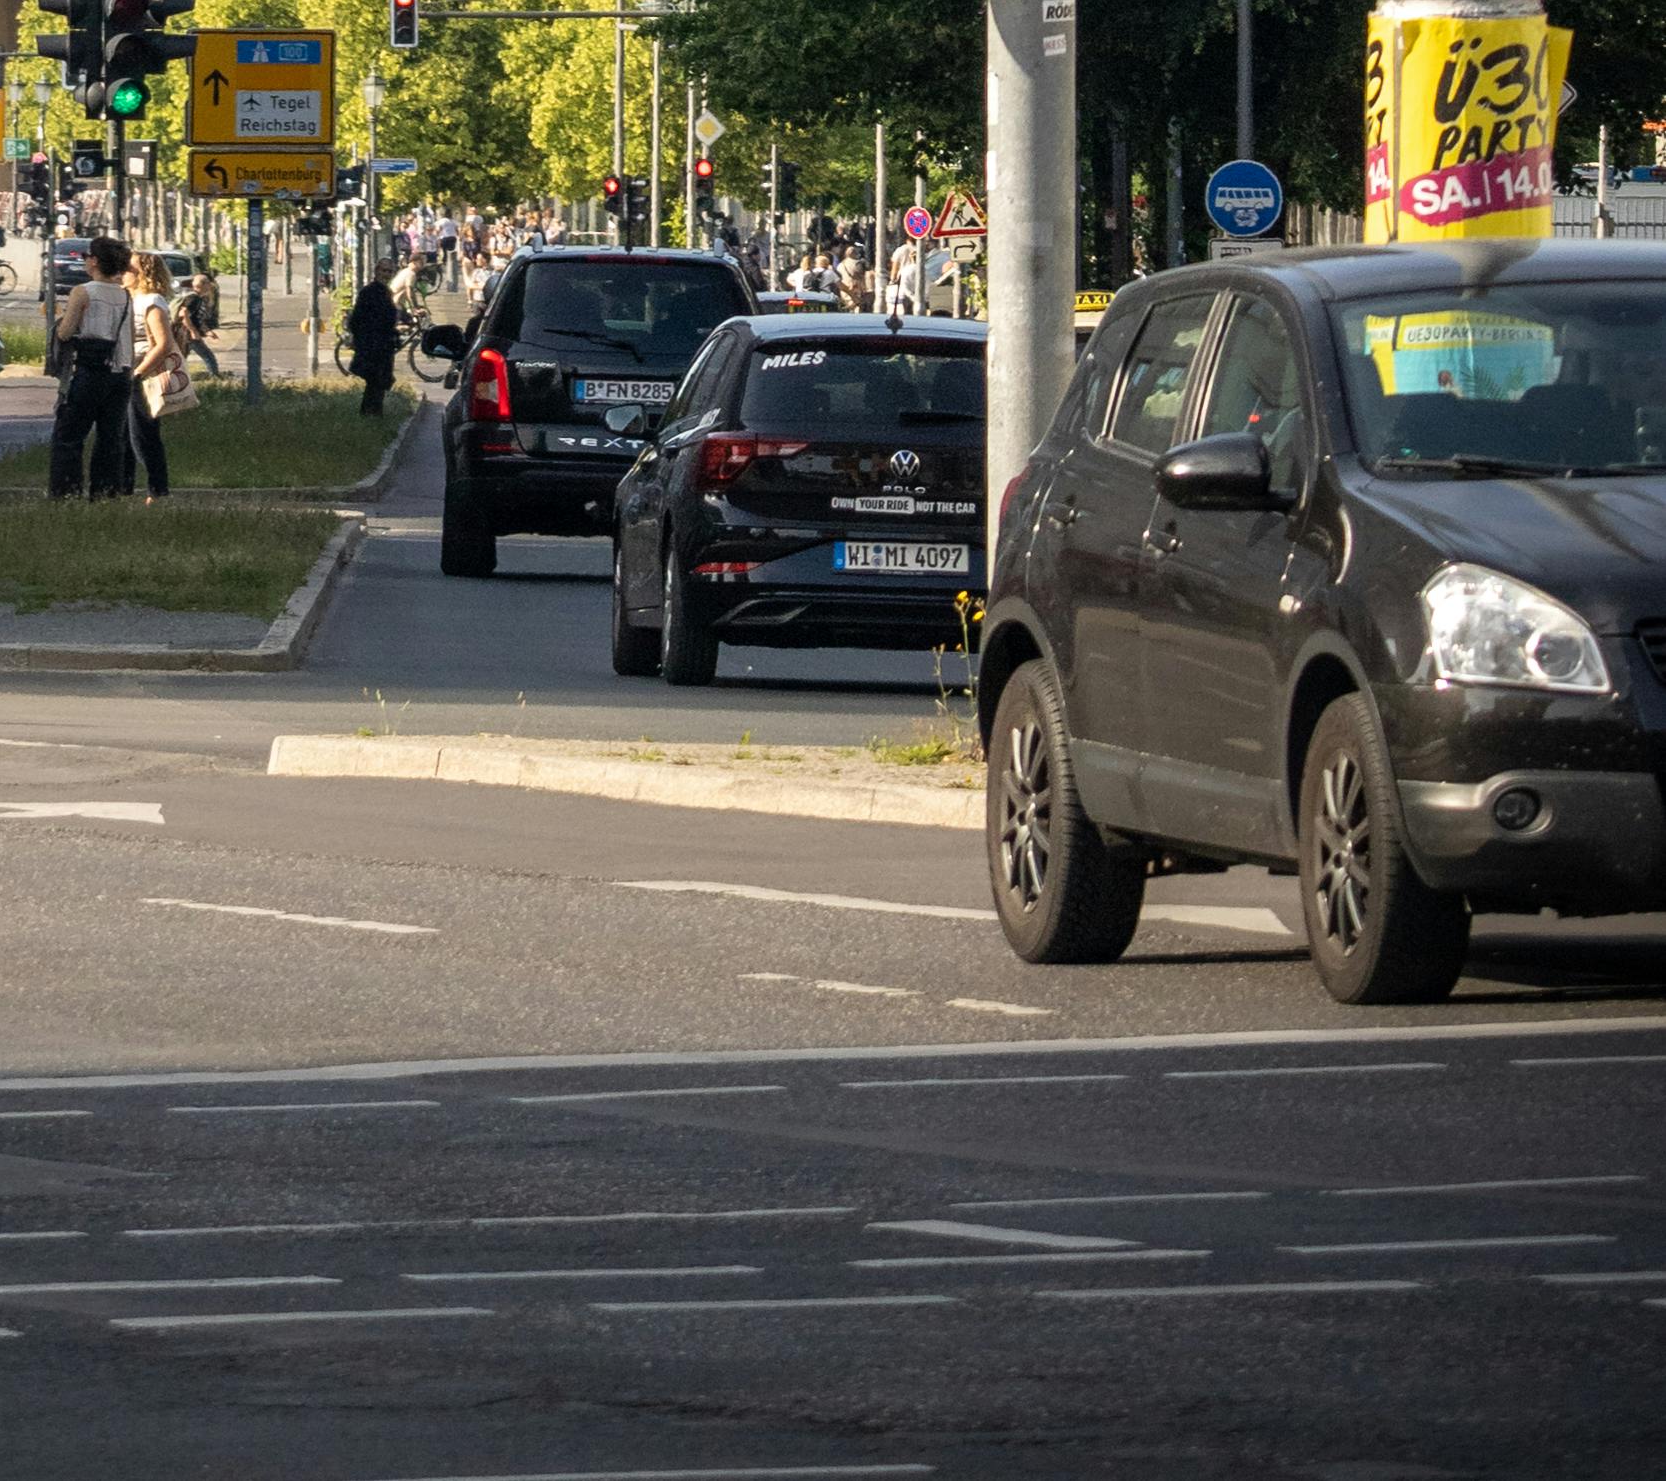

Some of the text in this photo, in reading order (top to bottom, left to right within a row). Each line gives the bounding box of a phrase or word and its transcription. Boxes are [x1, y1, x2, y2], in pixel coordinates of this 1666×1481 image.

[270, 95, 310, 113] Tegel
[240, 118, 316, 135] Reichstag
[1433, 114, 1550, 171] PARTY
[235, 166, 322, 183] Charlottenburg
[1411, 175, 1482, 215] SA.
[1075, 295, 1108, 305] TAXI
[761, 351, 827, 370] MILES
[585, 383, 672, 400] B FN 8285
[882, 485, 927, 494] POLO
[831, 497, 976, 514] OWN YOUR RIDE NOT THE CAR
[847, 545, 963, 569] WI MI 4097
